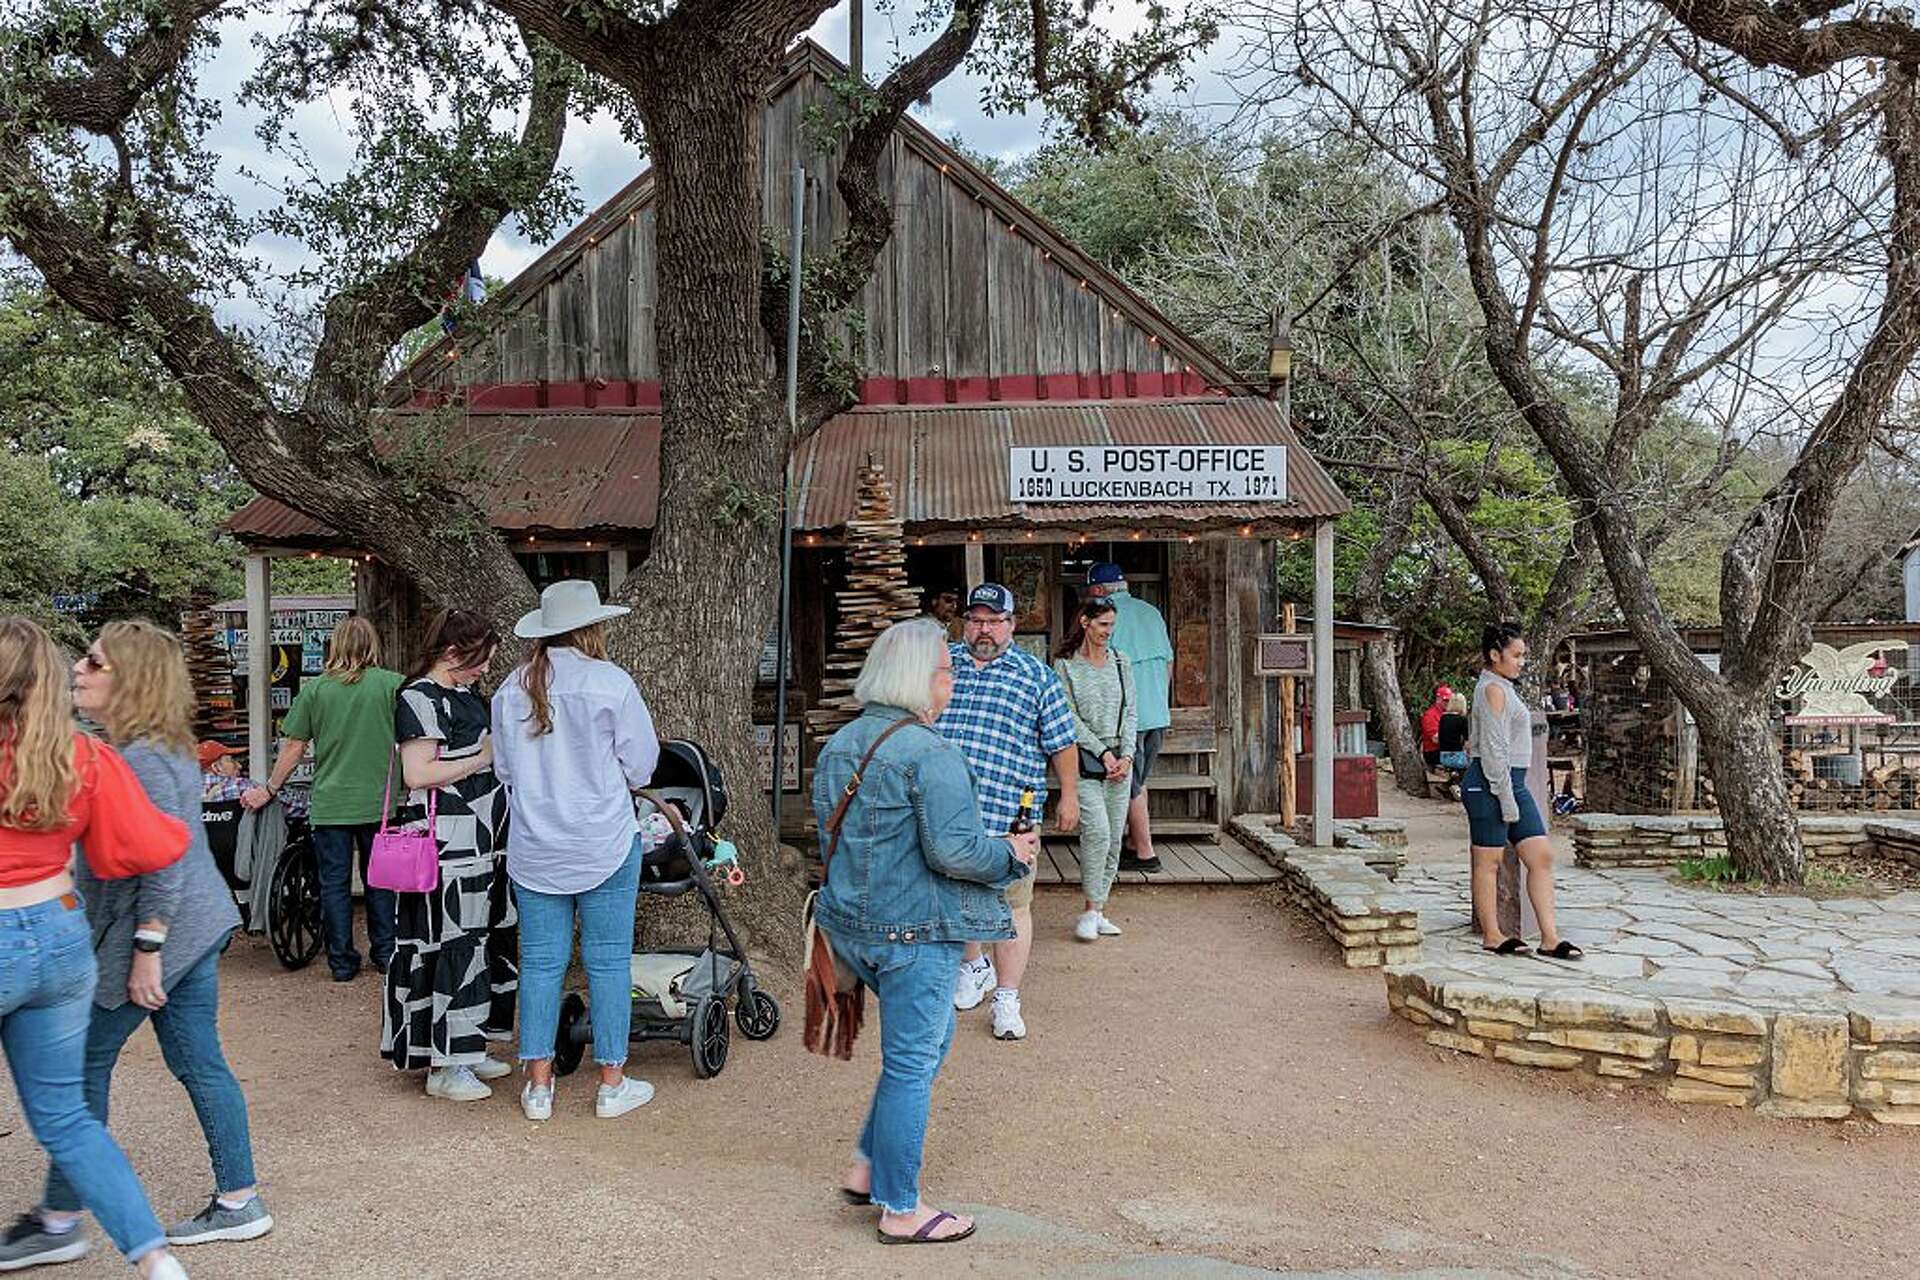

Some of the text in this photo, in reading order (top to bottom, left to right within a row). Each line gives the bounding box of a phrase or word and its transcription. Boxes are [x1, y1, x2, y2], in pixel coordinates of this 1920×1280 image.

[1031, 449, 1265, 473] U. S. POST-OFFICE
[1060, 480, 1193, 498] LUCKENBACH
[1207, 480, 1236, 496] TX.
[1245, 475, 1278, 496] 1971
[1775, 664, 1899, 699] Yuengling
